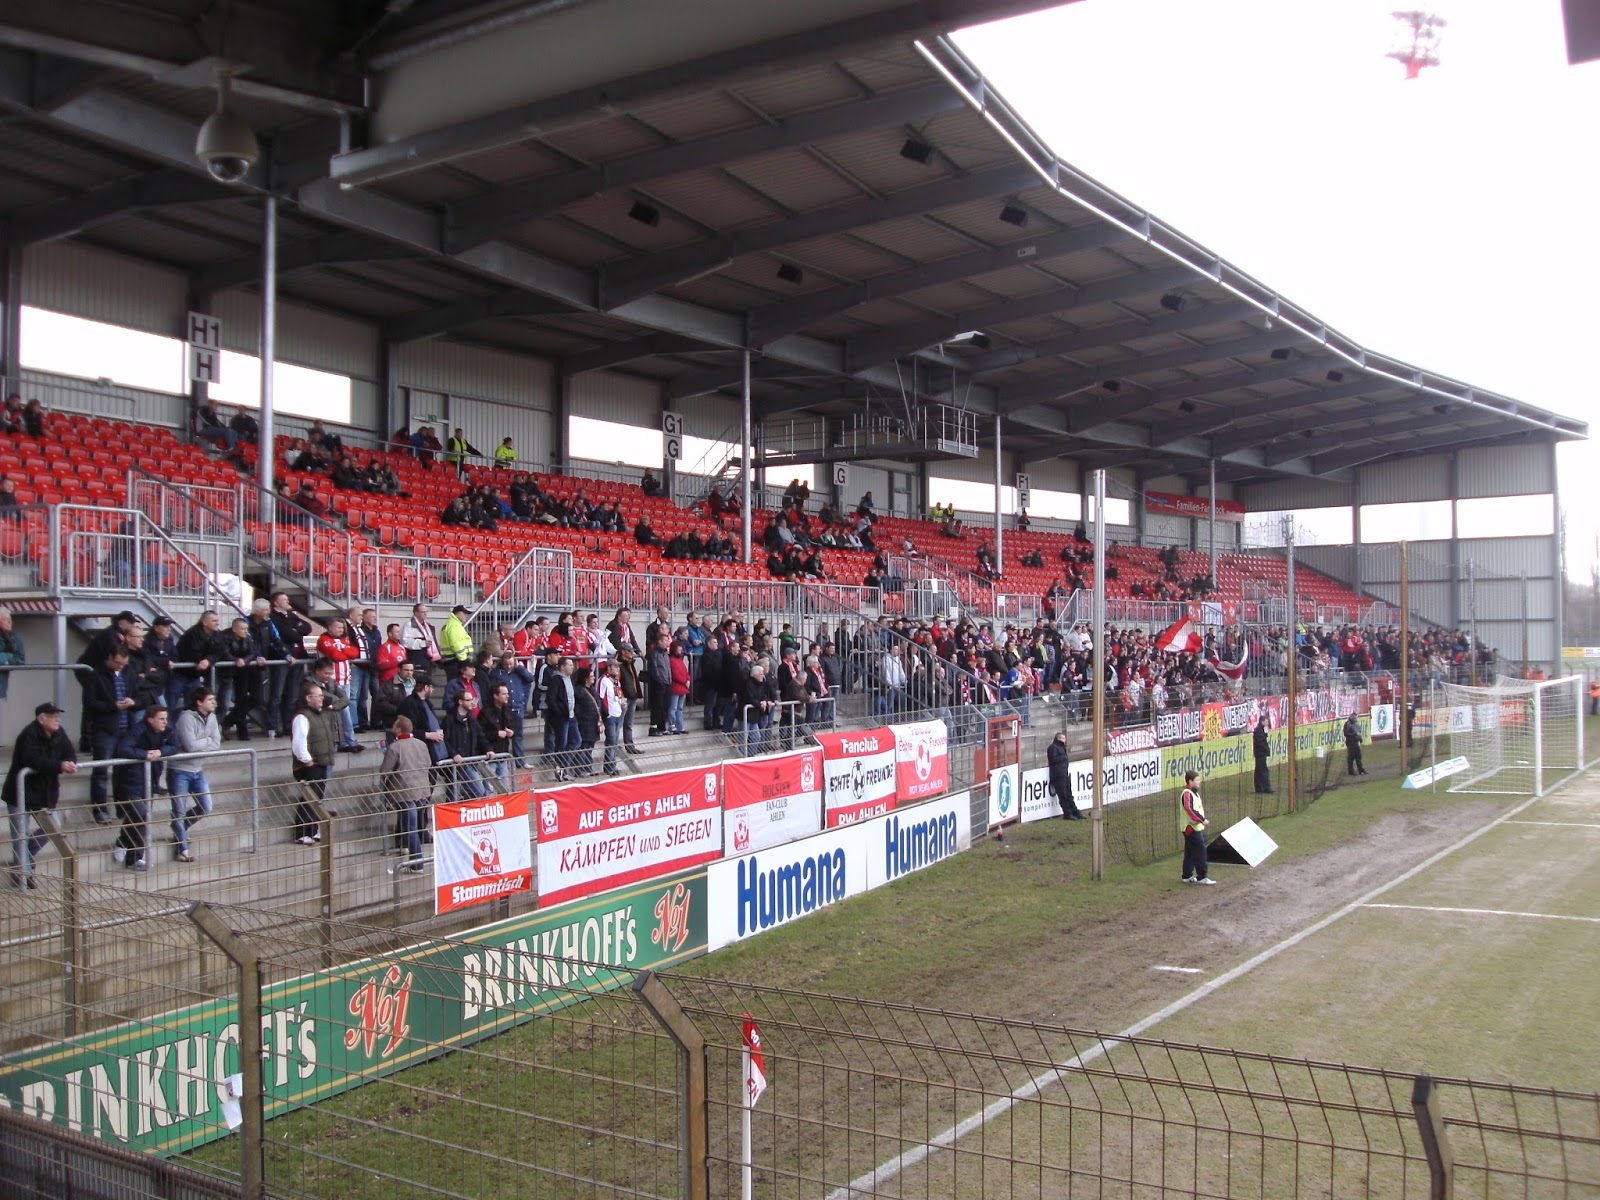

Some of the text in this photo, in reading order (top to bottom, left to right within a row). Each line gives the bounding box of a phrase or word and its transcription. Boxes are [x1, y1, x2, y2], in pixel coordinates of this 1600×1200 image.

[191, 316, 219, 348] H1
[196, 352, 213, 380] H
[664, 414, 682, 435] G1
[667, 439, 679, 458] G
[837, 467, 846, 484] G
[1018, 475, 1029, 490] F1
[1020, 492, 1027, 506] F
[840, 735, 879, 754] Fanclub
[1219, 740, 1246, 767] credit
[1122, 757, 1159, 783] heroal
[830, 773, 851, 793] ECHTE
[460, 802, 505, 823] Fanclub
[578, 810, 604, 829] AUF
[655, 793, 691, 815] AHLEN
[766, 798, 788, 811] FAN-CLUB
[858, 802, 887, 821] AHLEN
[769, 811, 786, 823] AHLEN
[559, 834, 637, 873] KÄMPFEN
[665, 818, 712, 848] SIEGEN
[885, 810, 958, 881] Humana
[479, 864, 501, 875] AHLEN
[452, 875, 524, 904] Stammtisch
[737, 847, 846, 938] Humana
